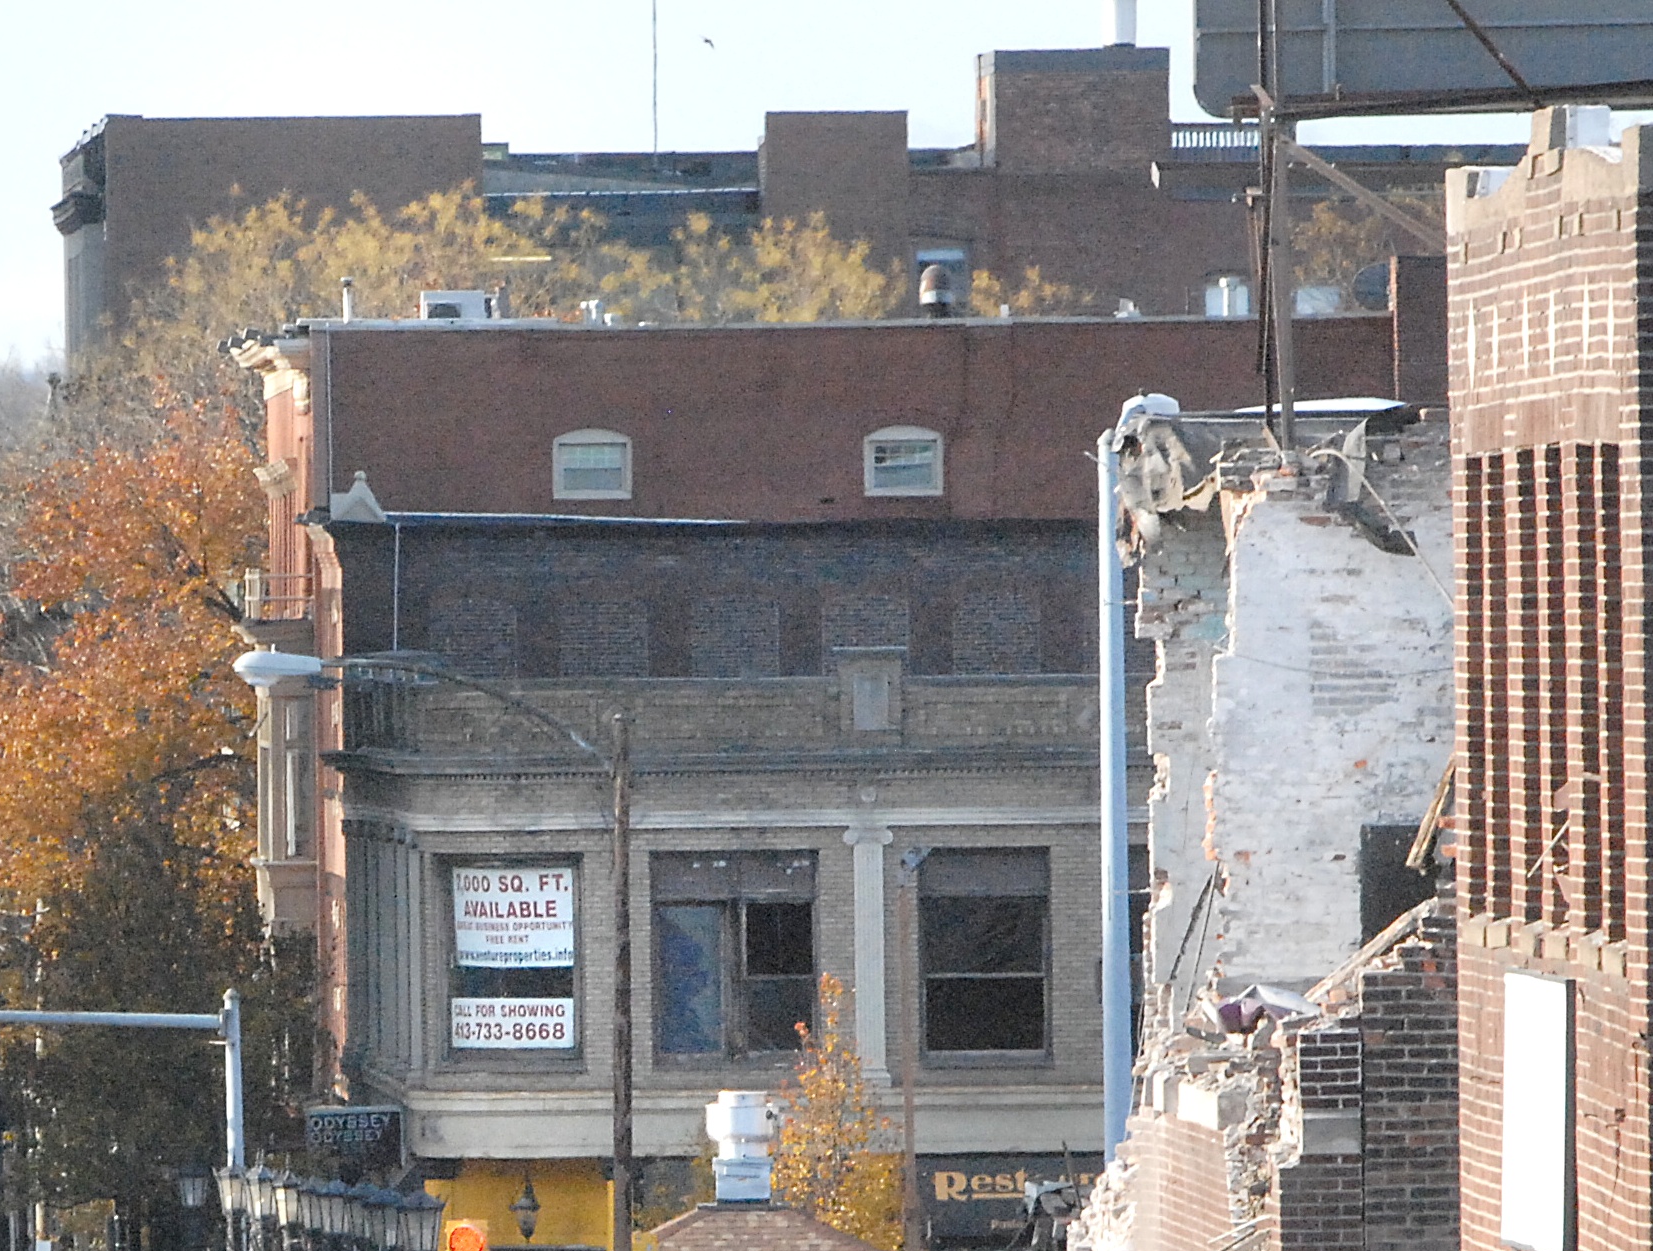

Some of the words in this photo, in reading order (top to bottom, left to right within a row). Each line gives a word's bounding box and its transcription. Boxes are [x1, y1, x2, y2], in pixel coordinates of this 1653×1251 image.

[498, 875, 530, 893] SQ.
[539, 873, 569, 892] FT.
[464, 899, 558, 918] AVAILABLE
[475, 1004, 496, 1017] FOR
[500, 1004, 566, 1017] SHOWING
[454, 1022, 566, 1040] 413-733-8668
[310, 1112, 390, 1130] ODYSSEY
